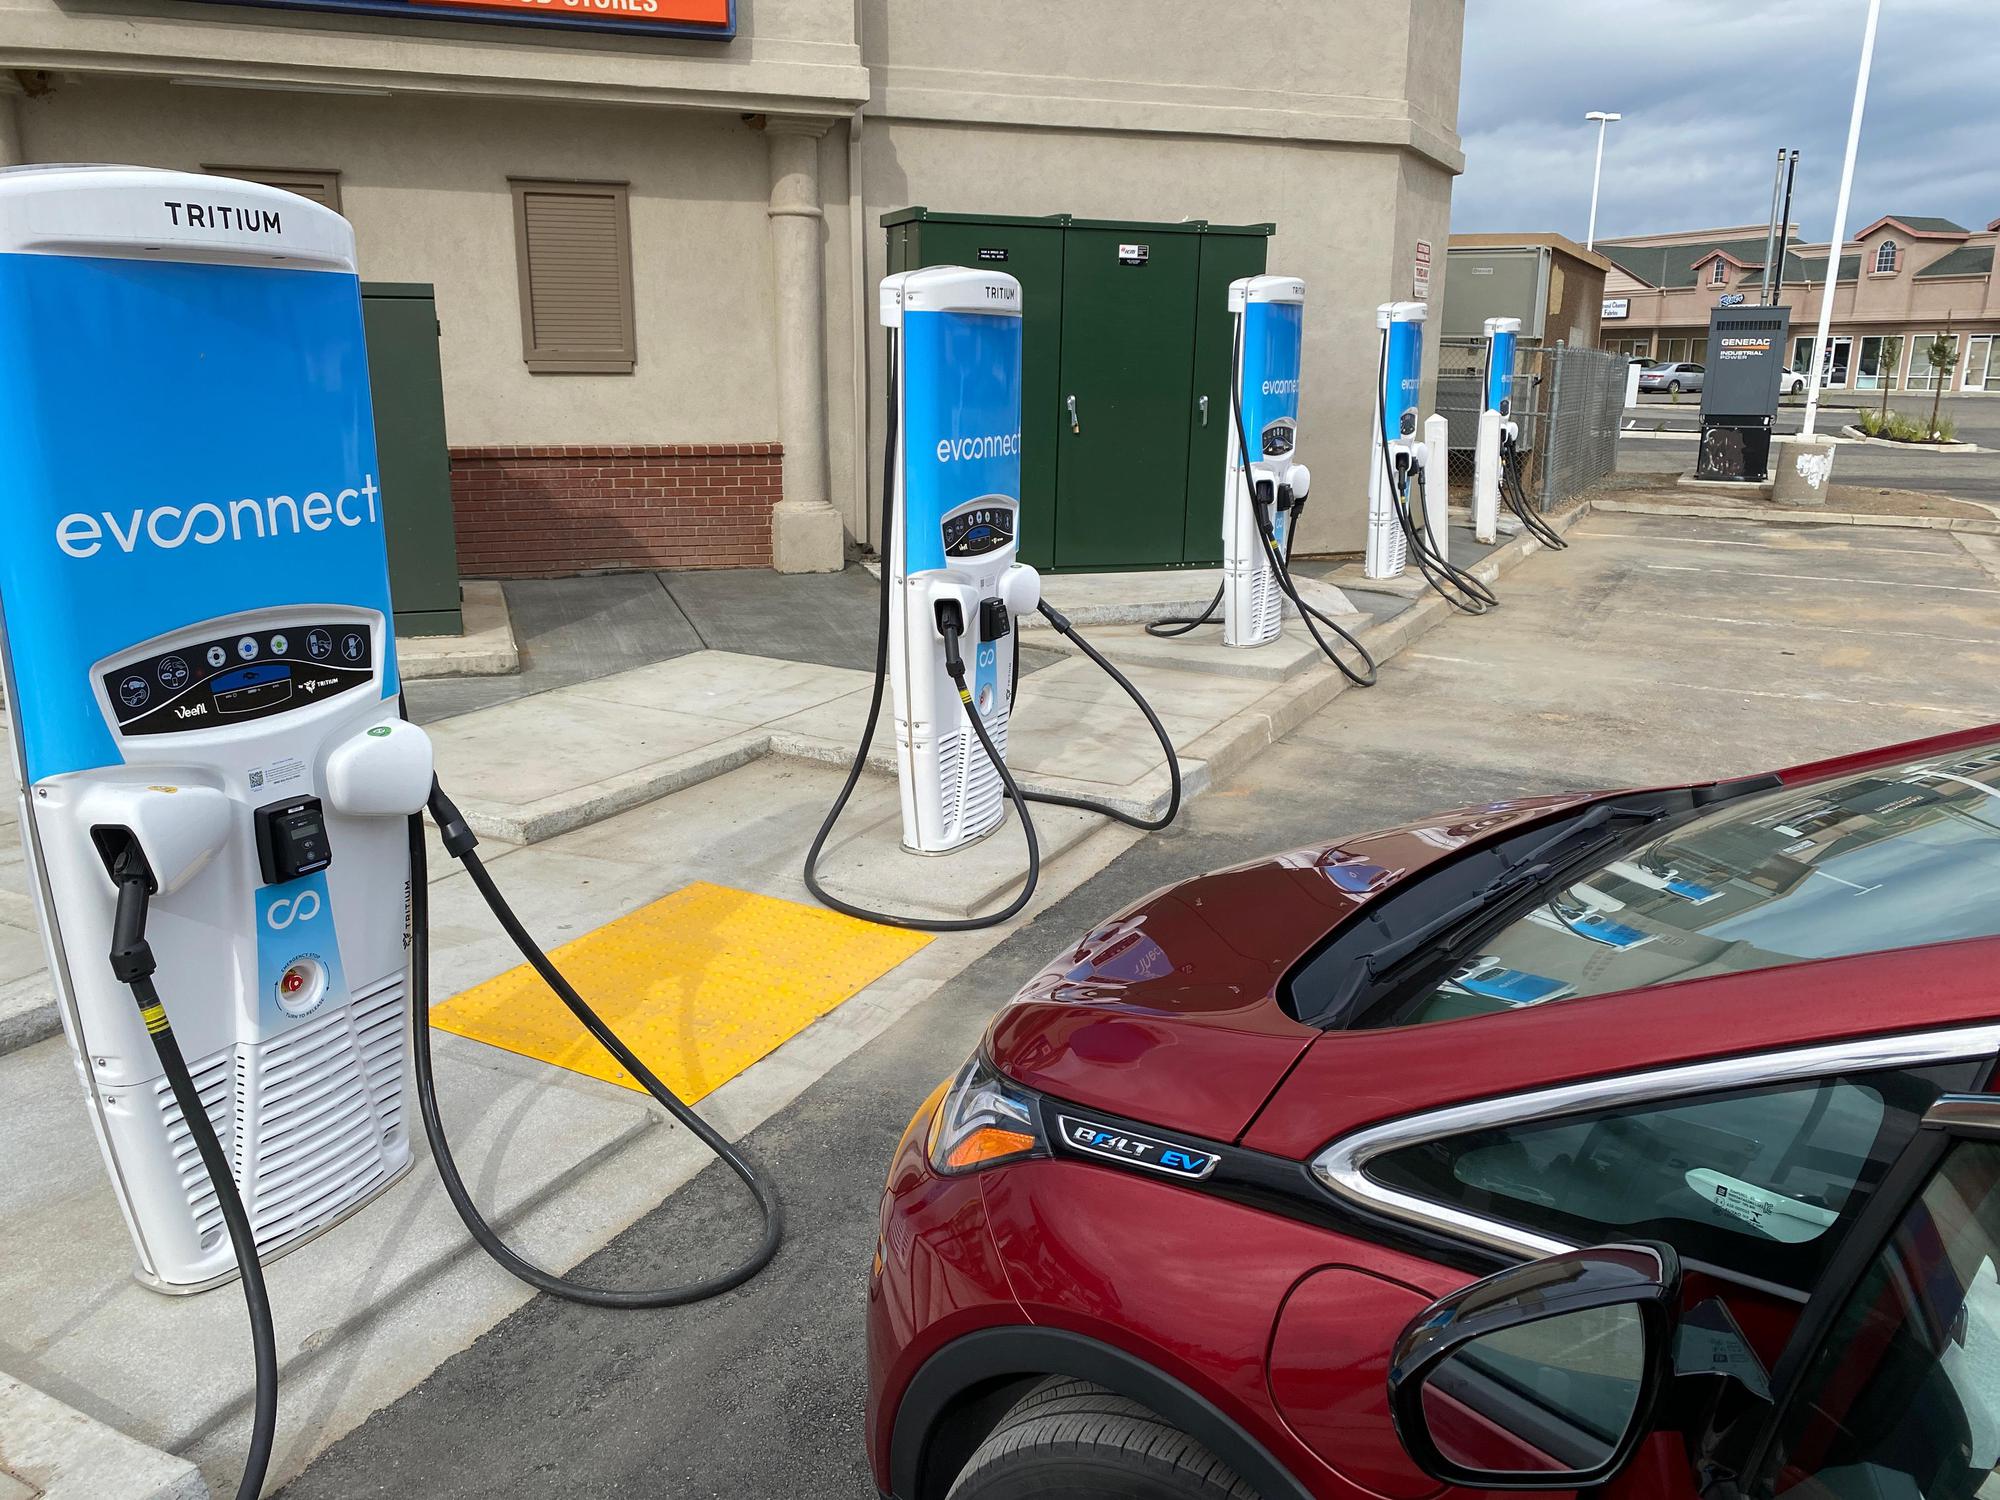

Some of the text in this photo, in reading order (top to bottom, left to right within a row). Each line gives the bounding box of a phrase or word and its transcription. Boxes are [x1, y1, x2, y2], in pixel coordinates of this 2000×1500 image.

[164, 201, 281, 234] TRITIUM
[985, 286, 1015, 300] TRITIUM
[1721, 338, 1771, 346] GENERAC
[937, 426, 1021, 463] evconnect
[55, 473, 378, 558] evconnect
[316, 677, 339, 688] TRITIUM
[404, 880, 412, 929] TRITIUM
[281, 952, 308, 973] EMERGENCY
[306, 998, 325, 1016] RELEASE
[1073, 1126, 1205, 1170] BOLT EV
